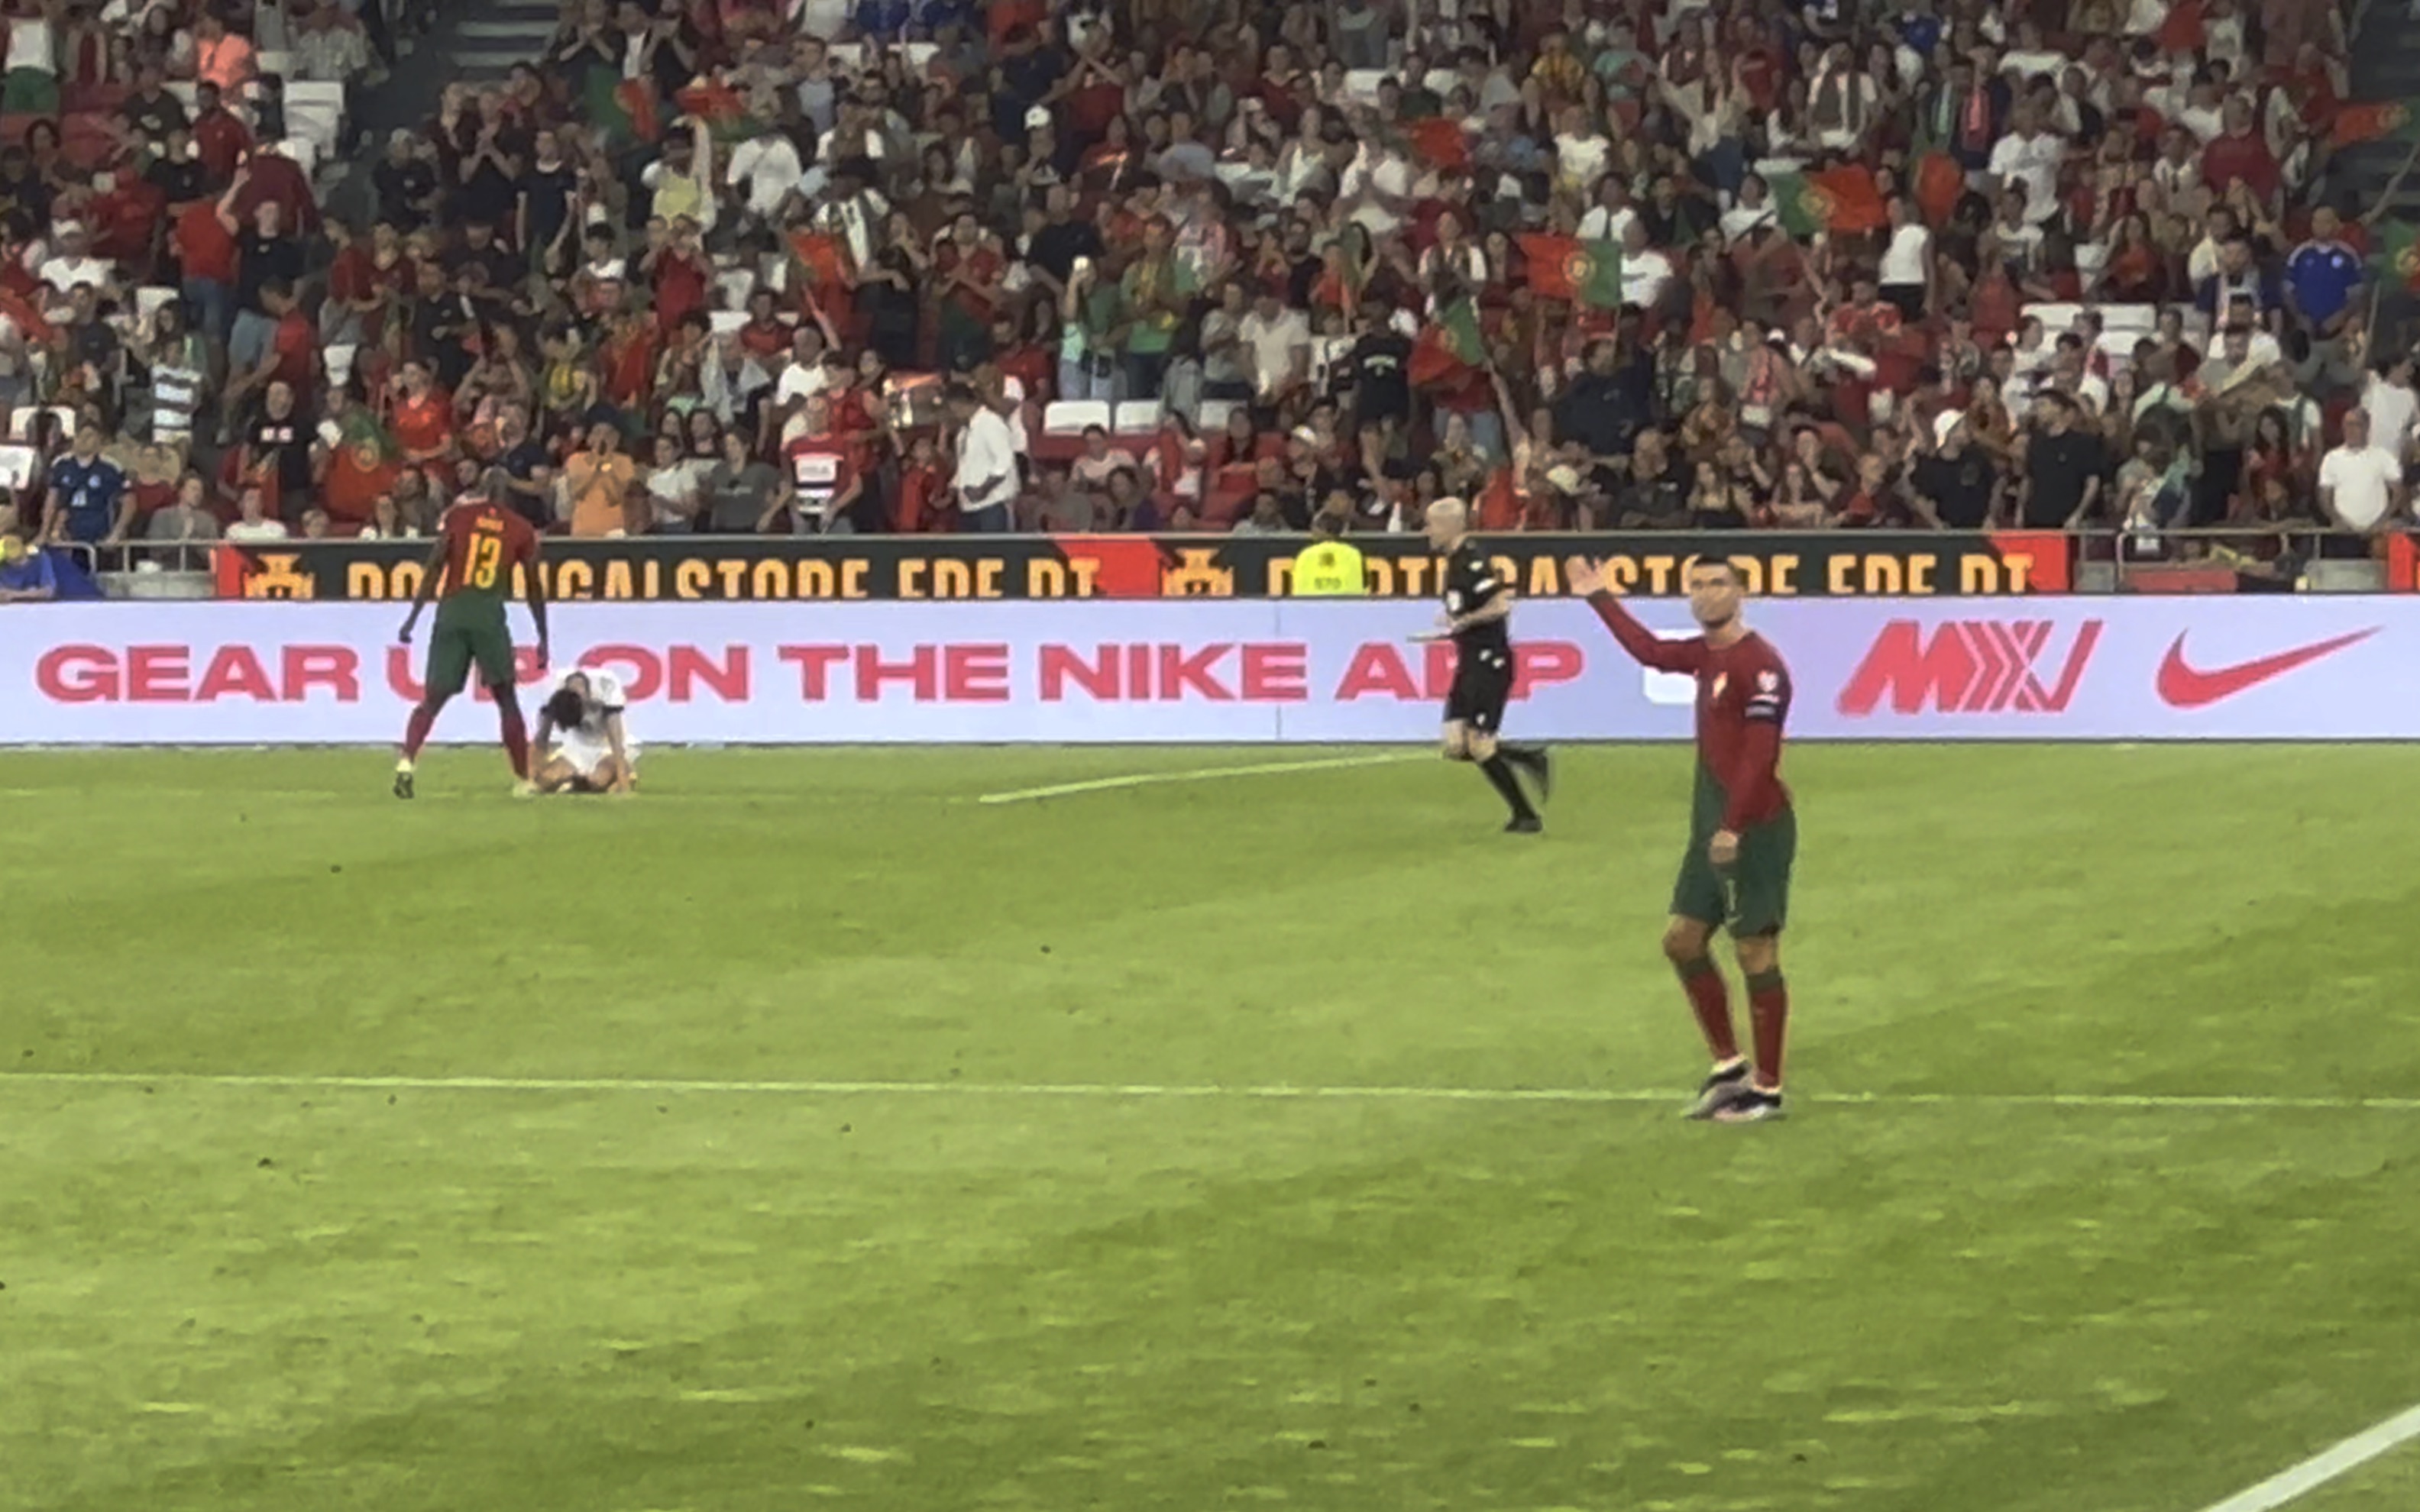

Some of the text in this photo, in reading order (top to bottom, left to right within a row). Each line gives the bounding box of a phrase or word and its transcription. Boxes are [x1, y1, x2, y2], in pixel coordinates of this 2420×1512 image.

[462, 532, 502, 590] 13
[36, 645, 359, 703] GEAR
[577, 645, 749, 701] ON
[778, 645, 1009, 700] THE
[1039, 644, 1308, 699] NIKE
